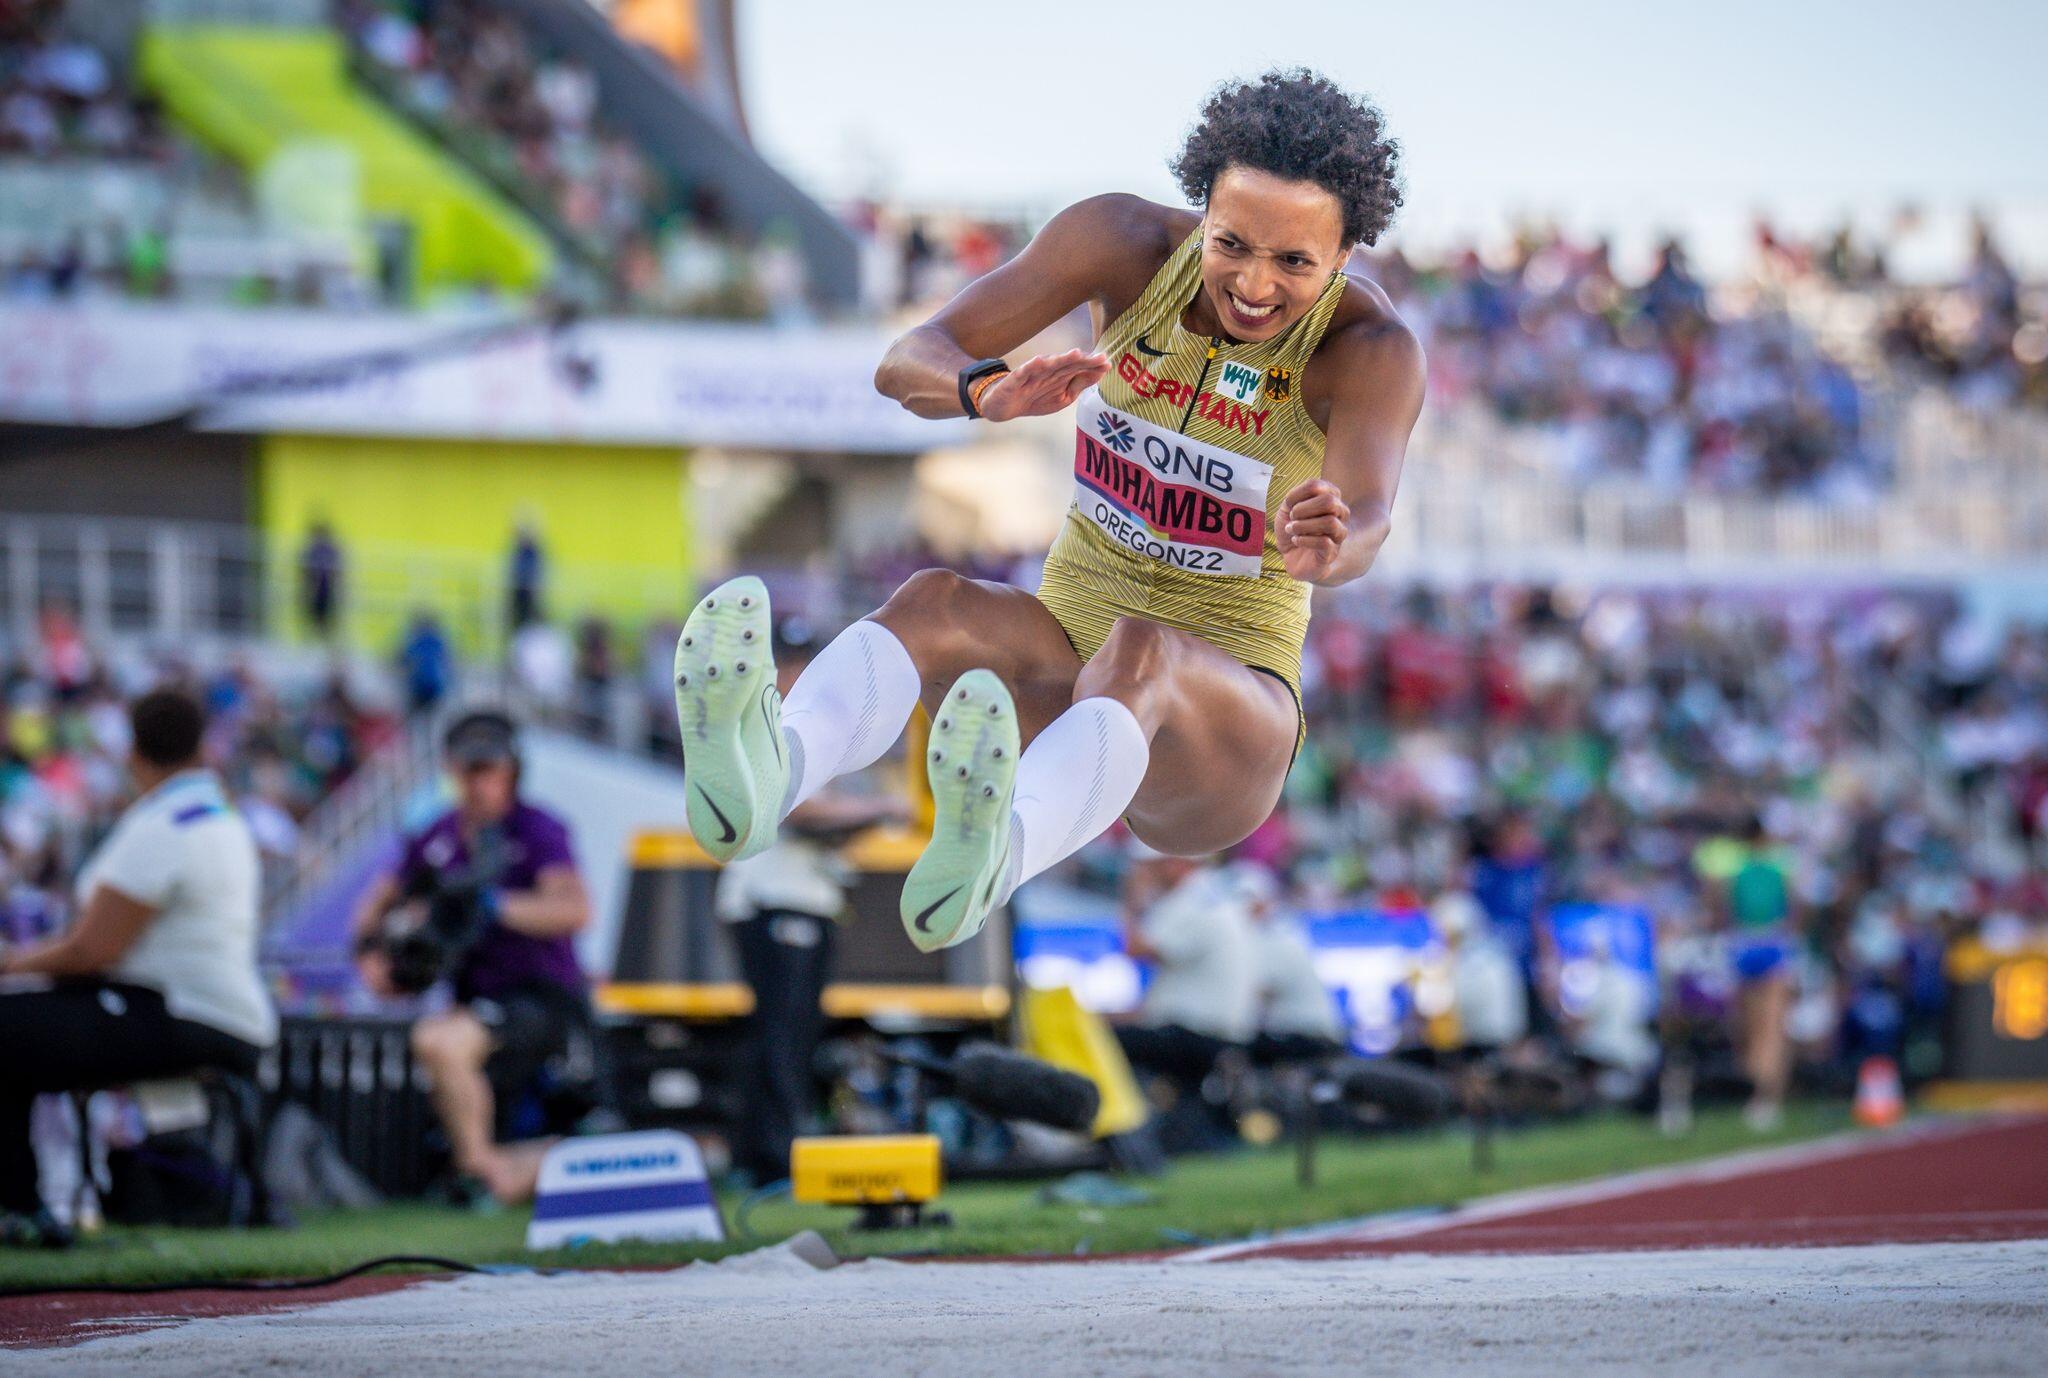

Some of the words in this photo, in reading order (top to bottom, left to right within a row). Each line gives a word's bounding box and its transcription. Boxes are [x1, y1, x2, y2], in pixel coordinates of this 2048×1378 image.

[1117, 352, 1270, 436] GERMANY
[1085, 438, 1252, 542] MIHAMBO
[1144, 435, 1234, 493] QNB
[1095, 503, 1223, 571] OREGON22
